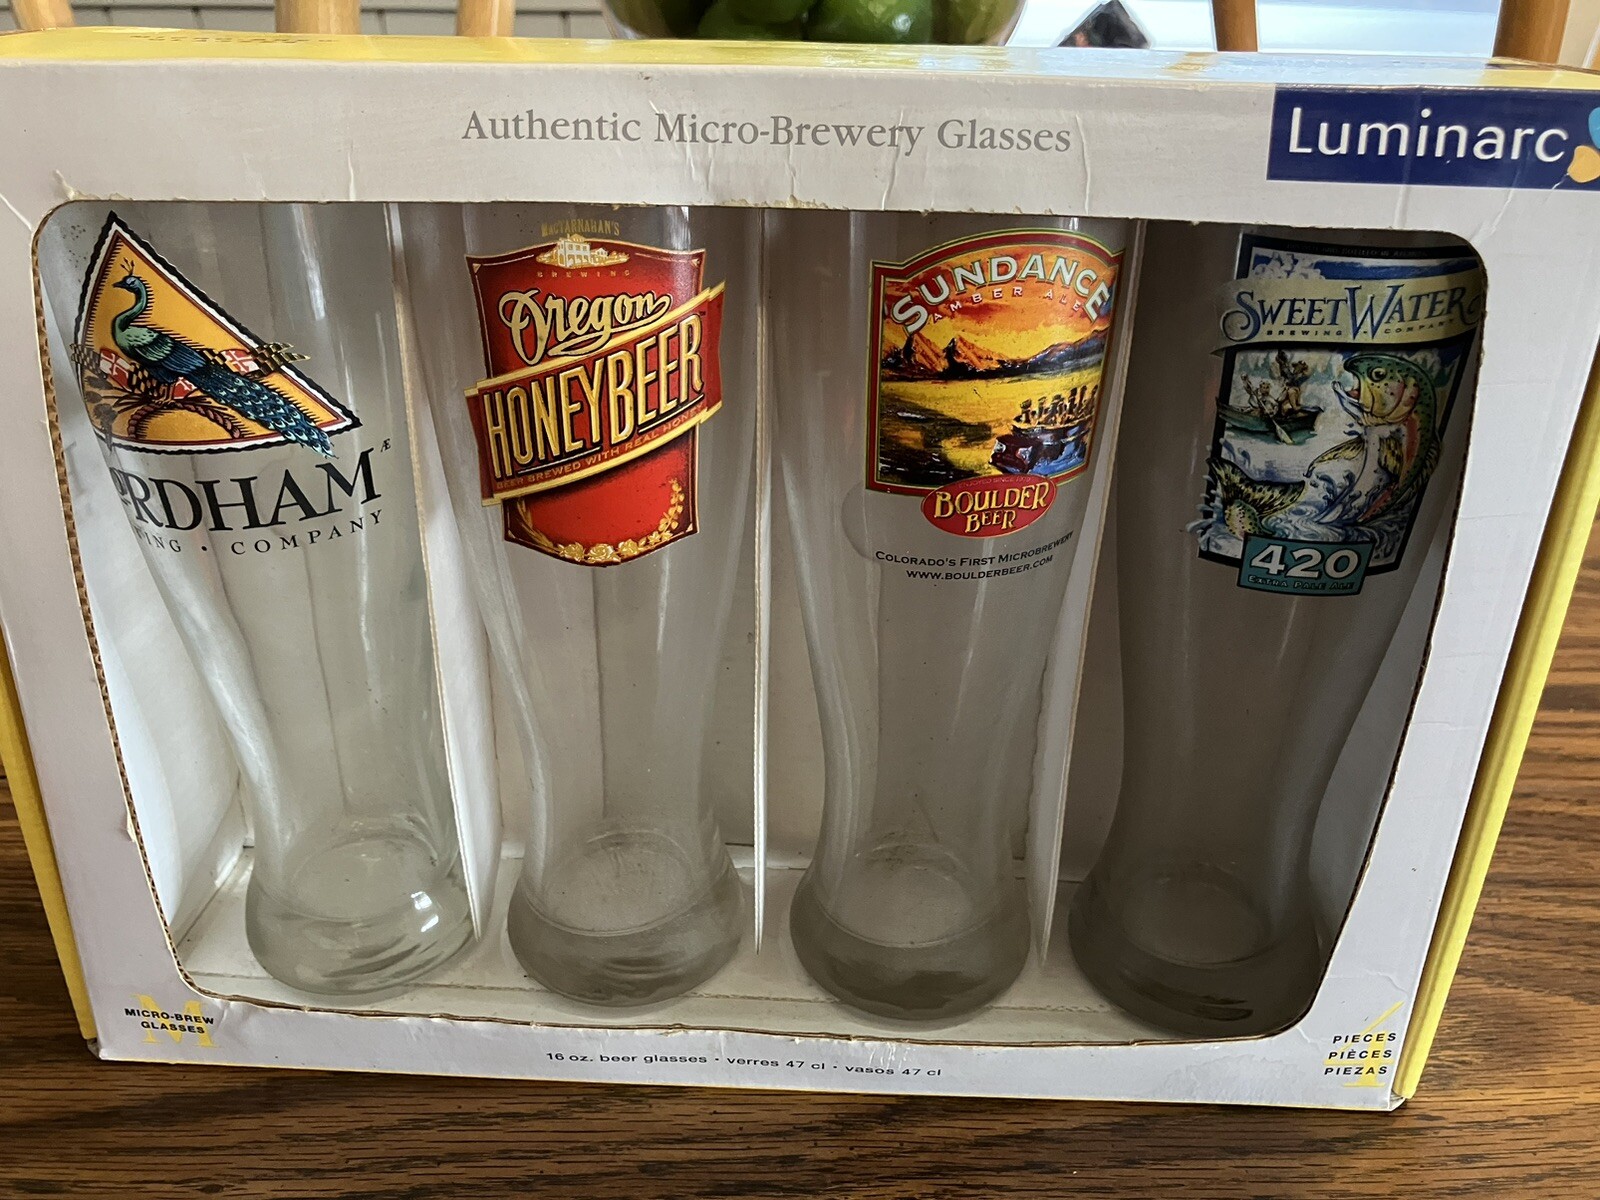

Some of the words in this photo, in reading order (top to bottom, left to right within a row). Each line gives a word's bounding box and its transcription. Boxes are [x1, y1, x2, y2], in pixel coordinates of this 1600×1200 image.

[462, 110, 640, 142] Authentic
[654, 113, 925, 156] Micro-Brewery
[937, 118, 1071, 152] Glasses
[1288, 107, 1569, 163] Luminarc
[891, 254, 1111, 335] SUNDANCE
[933, 286, 1022, 322] AMBER
[1046, 288, 1082, 312] ALE
[499, 290, 671, 366] Oregon
[1384, 318, 1454, 334] COMPANY
[528, 461, 581, 482] BREWED
[585, 447, 620, 467] WITH
[625, 431, 658, 450] REAL
[662, 403, 704, 433] HONEY
[933, 481, 1050, 519] BOULDER
[231, 509, 383, 555] COMPANY
[964, 509, 1017, 533] BEER
[875, 550, 956, 567] COLORADO'S
[959, 556, 996, 567] FIRST
[997, 530, 1074, 564] MICROBREWERY
[1251, 544, 1361, 580] 420
[906, 554, 1054, 581] WWW.BOULDERBEER.COM
[1248, 575, 1288, 588] EXTRA
[1293, 581, 1326, 590] PALE
[1329, 581, 1354, 590] ALE
[124, 1008, 214, 1025] MICRO-BREW
[141, 1021, 205, 1034] GLASSES
[1332, 1032, 1397, 1044] PIECES
[546, 1052, 564, 1061] 16
[600, 1054, 638, 1062] beer
[643, 1054, 707, 1064] glasses
[727, 1057, 779, 1067] verres
[845, 1066, 894, 1075] vasos
[902, 1068, 921, 1076] 47
[1328, 1049, 1392, 1060] PIÈCES
[1324, 1066, 1387, 1075] PIEZAS
